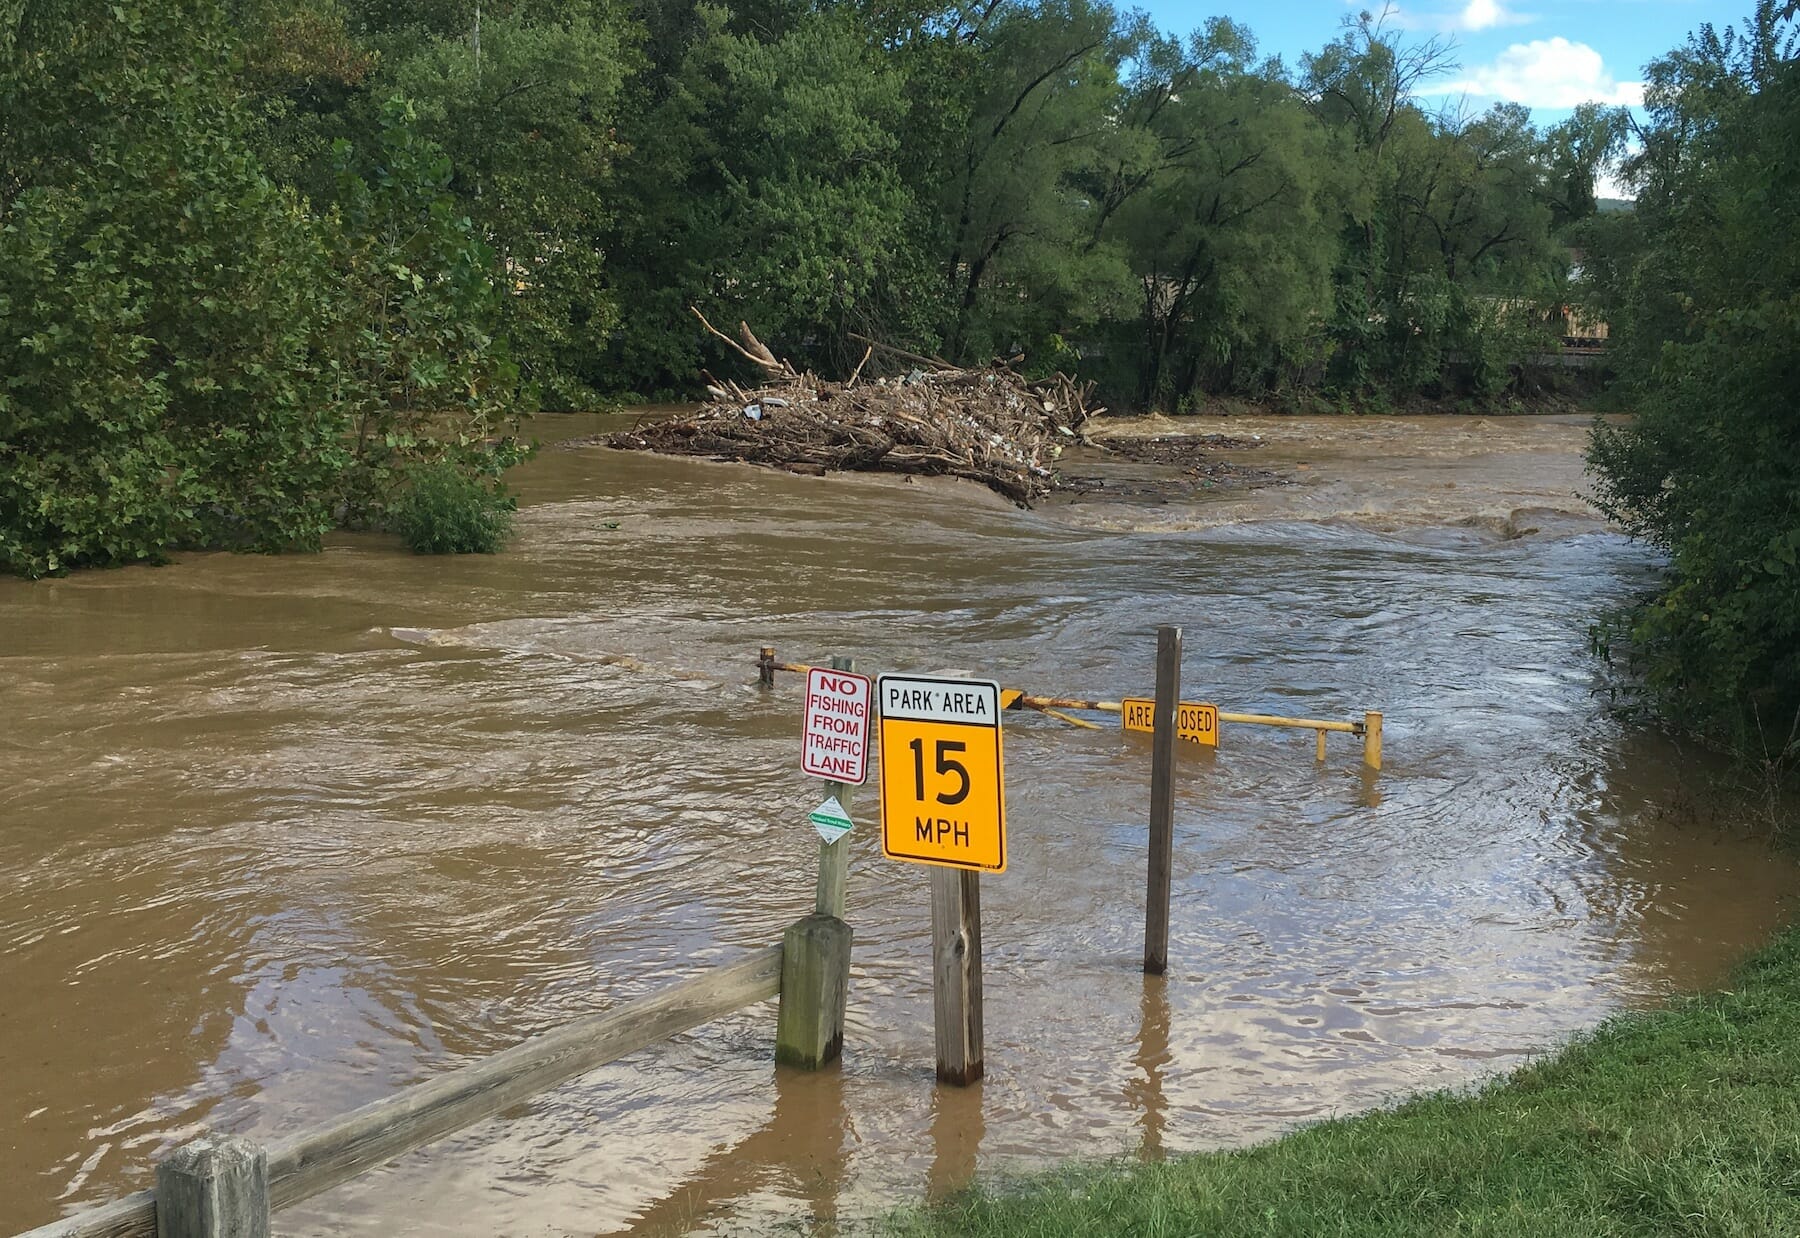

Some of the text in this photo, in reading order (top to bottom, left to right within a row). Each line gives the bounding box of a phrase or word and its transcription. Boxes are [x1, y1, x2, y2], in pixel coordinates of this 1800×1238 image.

[820, 676, 857, 696] NO
[810, 694, 864, 718] FISHING
[890, 688, 986, 715] PARK AREA
[813, 714, 859, 736] FROM
[1128, 705, 1212, 732] ARE OSED
[808, 732, 861, 757] TRAFFIC
[810, 753, 857, 776] LANE
[909, 738, 970, 805] 15
[915, 816, 969, 848] MPH
